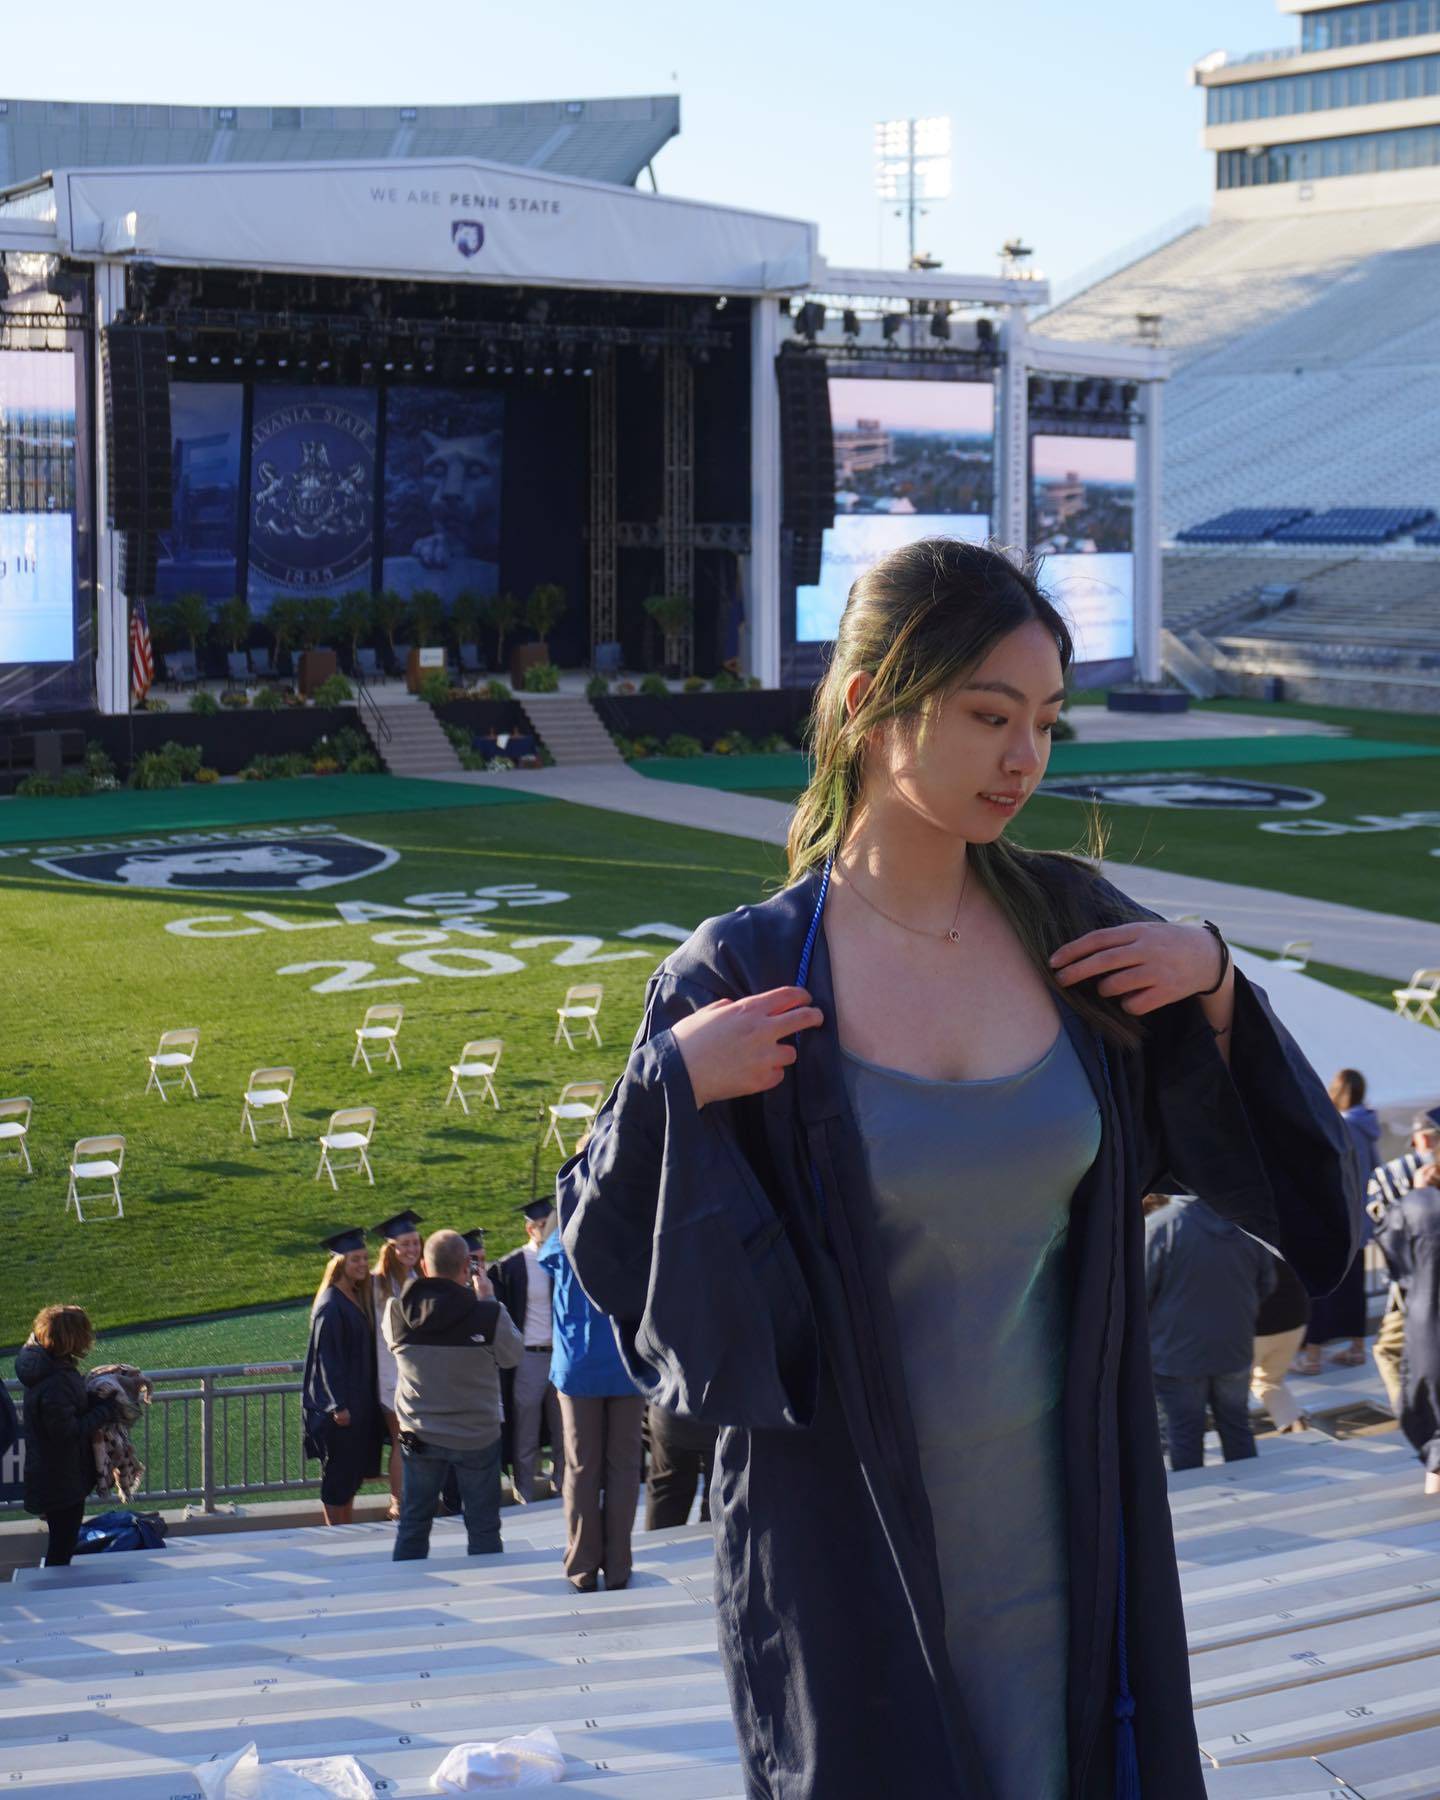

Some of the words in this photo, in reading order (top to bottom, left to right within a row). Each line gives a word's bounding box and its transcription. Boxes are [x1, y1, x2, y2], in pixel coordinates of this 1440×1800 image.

[370, 187, 397, 203] WE
[407, 189, 441, 205] ARE
[450, 193, 499, 209] PENN
[508, 197, 561, 214] STATE
[164, 884, 571, 938] CLASS
[1345, 1705, 1374, 1719] 20
[594, 1761, 609, 1771] 11
